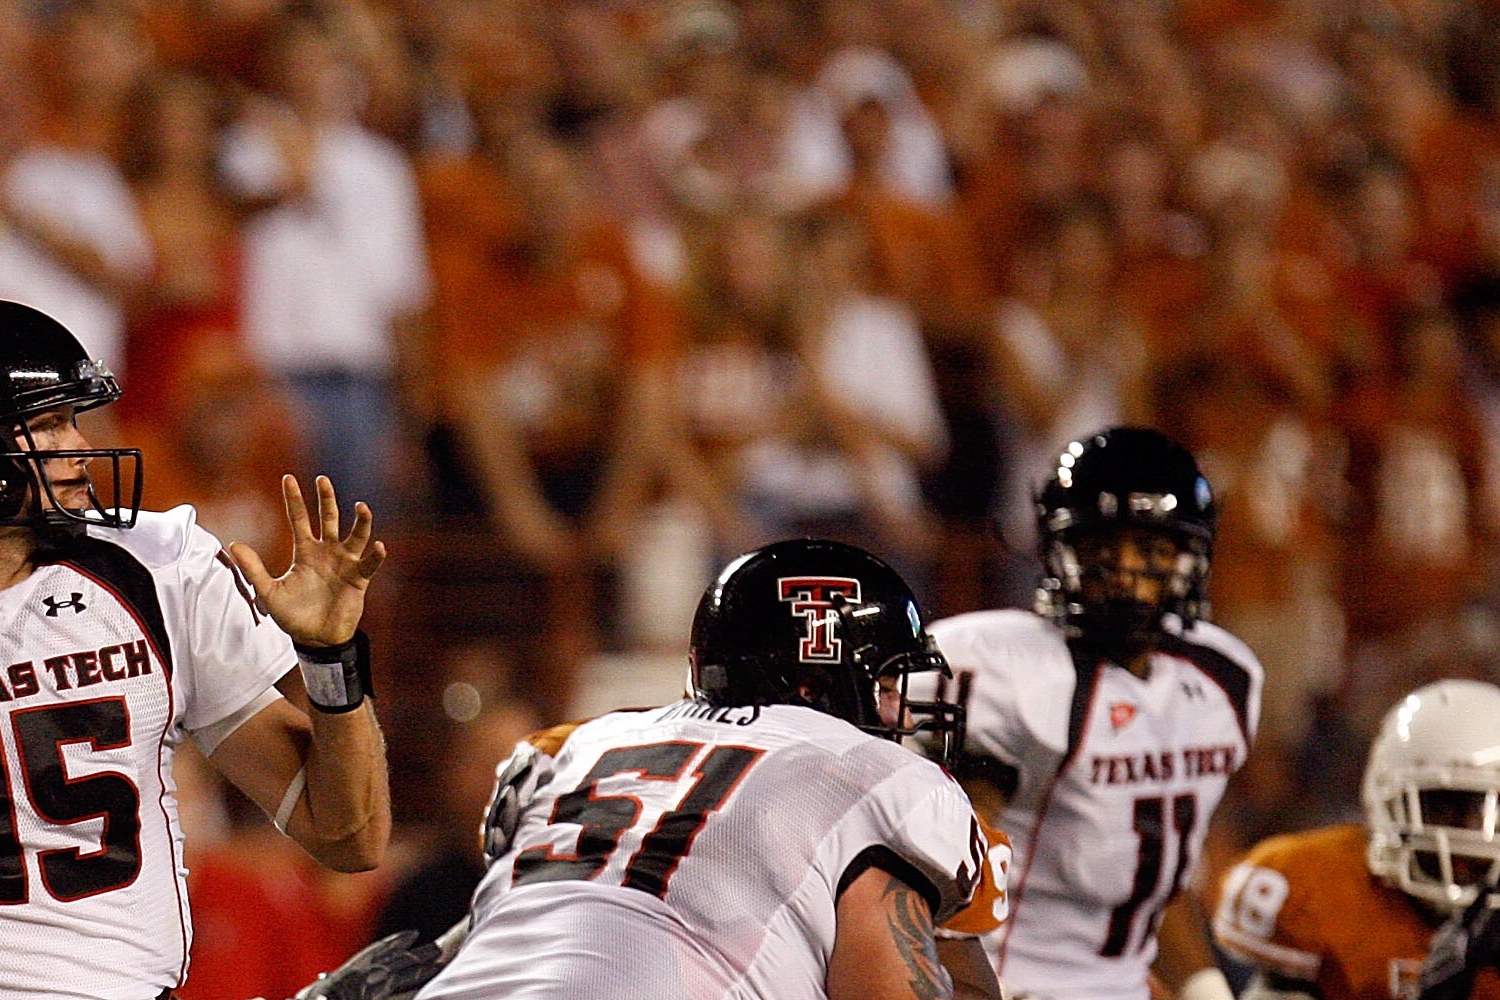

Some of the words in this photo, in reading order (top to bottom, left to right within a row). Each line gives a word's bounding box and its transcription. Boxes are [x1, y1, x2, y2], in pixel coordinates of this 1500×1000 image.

[44, 638, 154, 691] TECH
[510, 740, 768, 900] 51
[1091, 750, 1176, 785] TEXAS
[1097, 793, 1198, 957] 11
